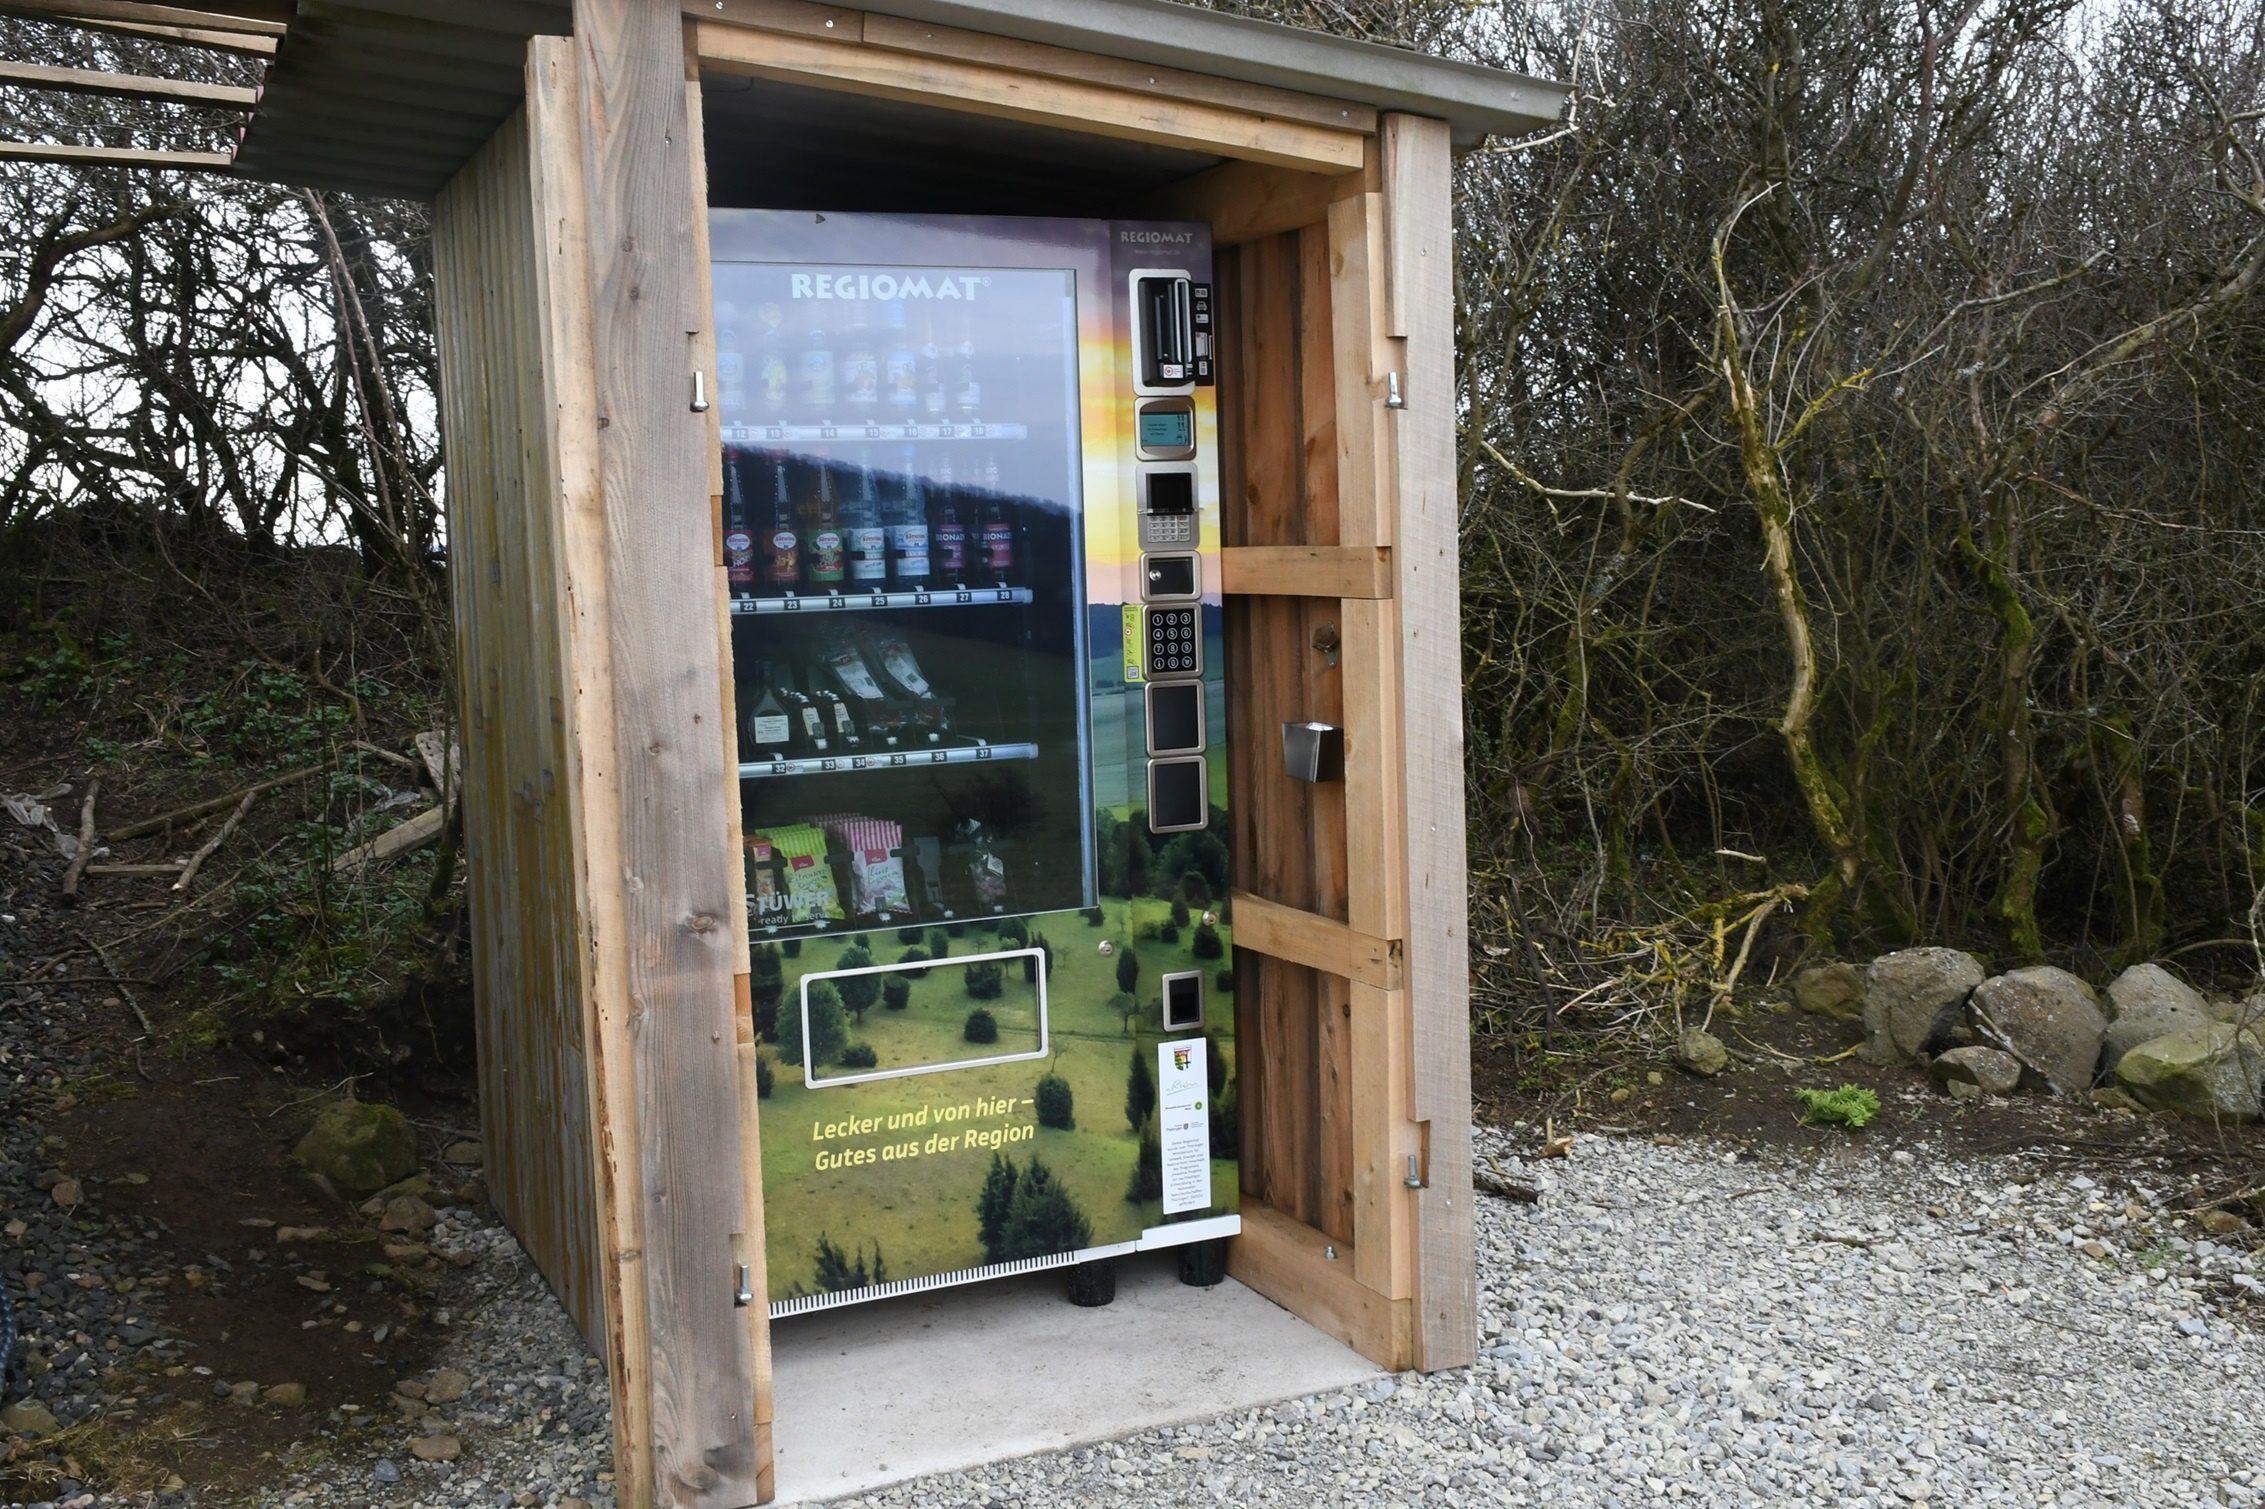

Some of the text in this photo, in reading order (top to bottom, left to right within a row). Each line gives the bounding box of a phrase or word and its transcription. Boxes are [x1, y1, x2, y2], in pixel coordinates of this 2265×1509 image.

[1120, 231, 1192, 244] REGIOMAT
[760, 914, 788, 925] ready
[812, 1115, 884, 1141] Lecker
[888, 1105, 929, 1130] und
[933, 1104, 970, 1123] von
[976, 1096, 1017, 1117] hier
[815, 1123, 1034, 1171] Gutes aus der Region
